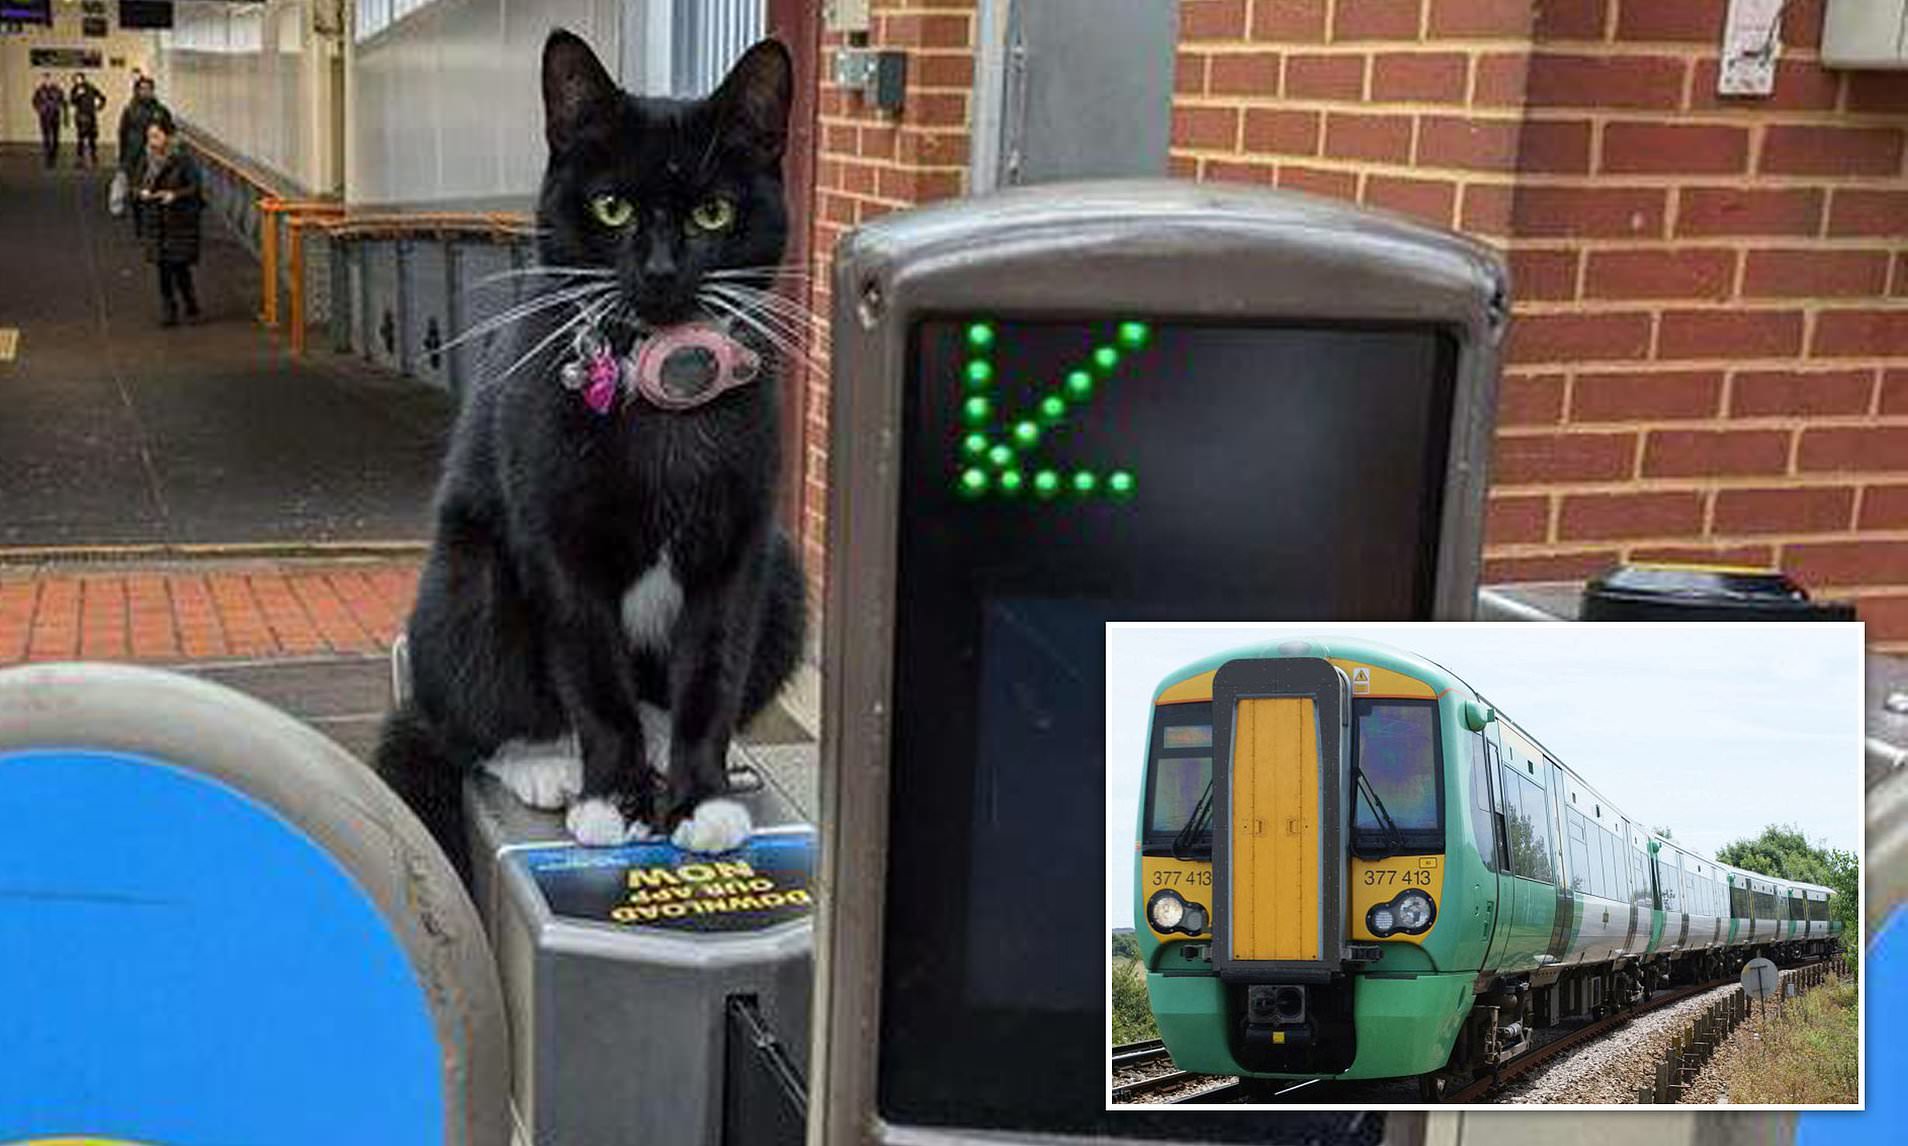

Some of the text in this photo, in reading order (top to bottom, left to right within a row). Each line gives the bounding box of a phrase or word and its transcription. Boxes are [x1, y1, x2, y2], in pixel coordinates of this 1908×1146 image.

[628, 861, 754, 888] NOW
[1152, 871, 1212, 886] 377 413
[1364, 870, 1431, 886] 377 413
[630, 877, 775, 903] OUR APP
[610, 890, 811, 921] DOWNLOAD
